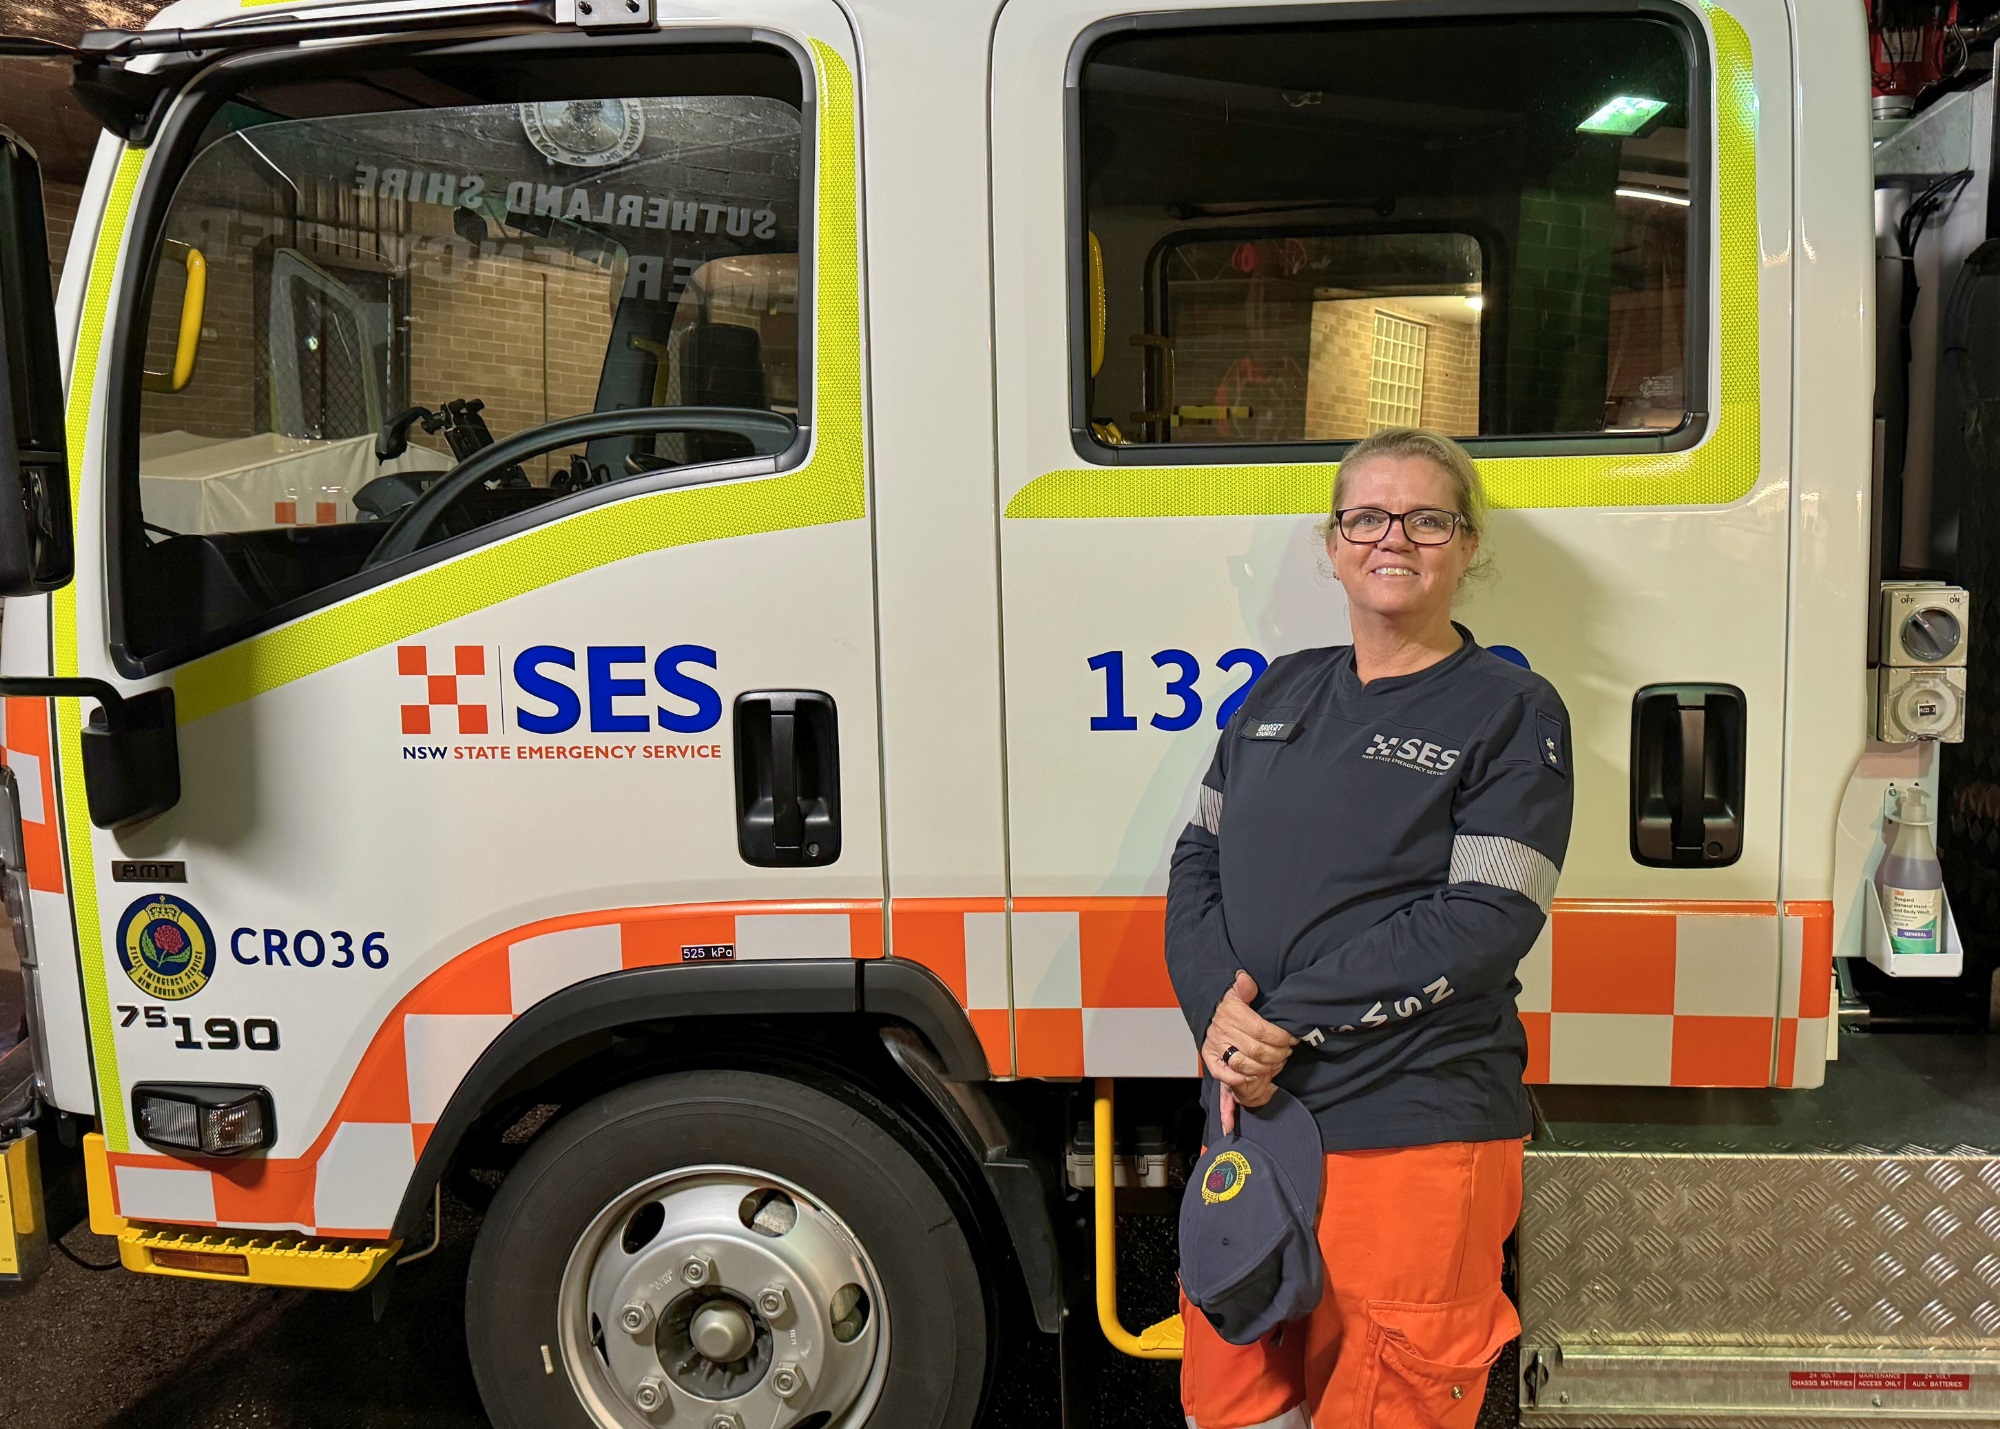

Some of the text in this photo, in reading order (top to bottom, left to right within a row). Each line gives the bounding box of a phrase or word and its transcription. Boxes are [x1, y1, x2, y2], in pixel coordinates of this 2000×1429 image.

[513, 644, 723, 735] SES
[1087, 648, 1269, 731] 132
[403, 744, 722, 760] NSW STATE EMERGENCY SERVICE
[1391, 758, 1425, 773] EMERGENCY
[1396, 738, 1460, 770] SES
[122, 864, 174, 878] AMT
[231, 927, 390, 969] CRO36
[683, 947, 733, 959] 525 kPa
[129, 946, 202, 986] STATE EMERGENCY SERVICE
[137, 976, 199, 996] NEW SOUTH WALES
[117, 1005, 281, 1051] 75 190
